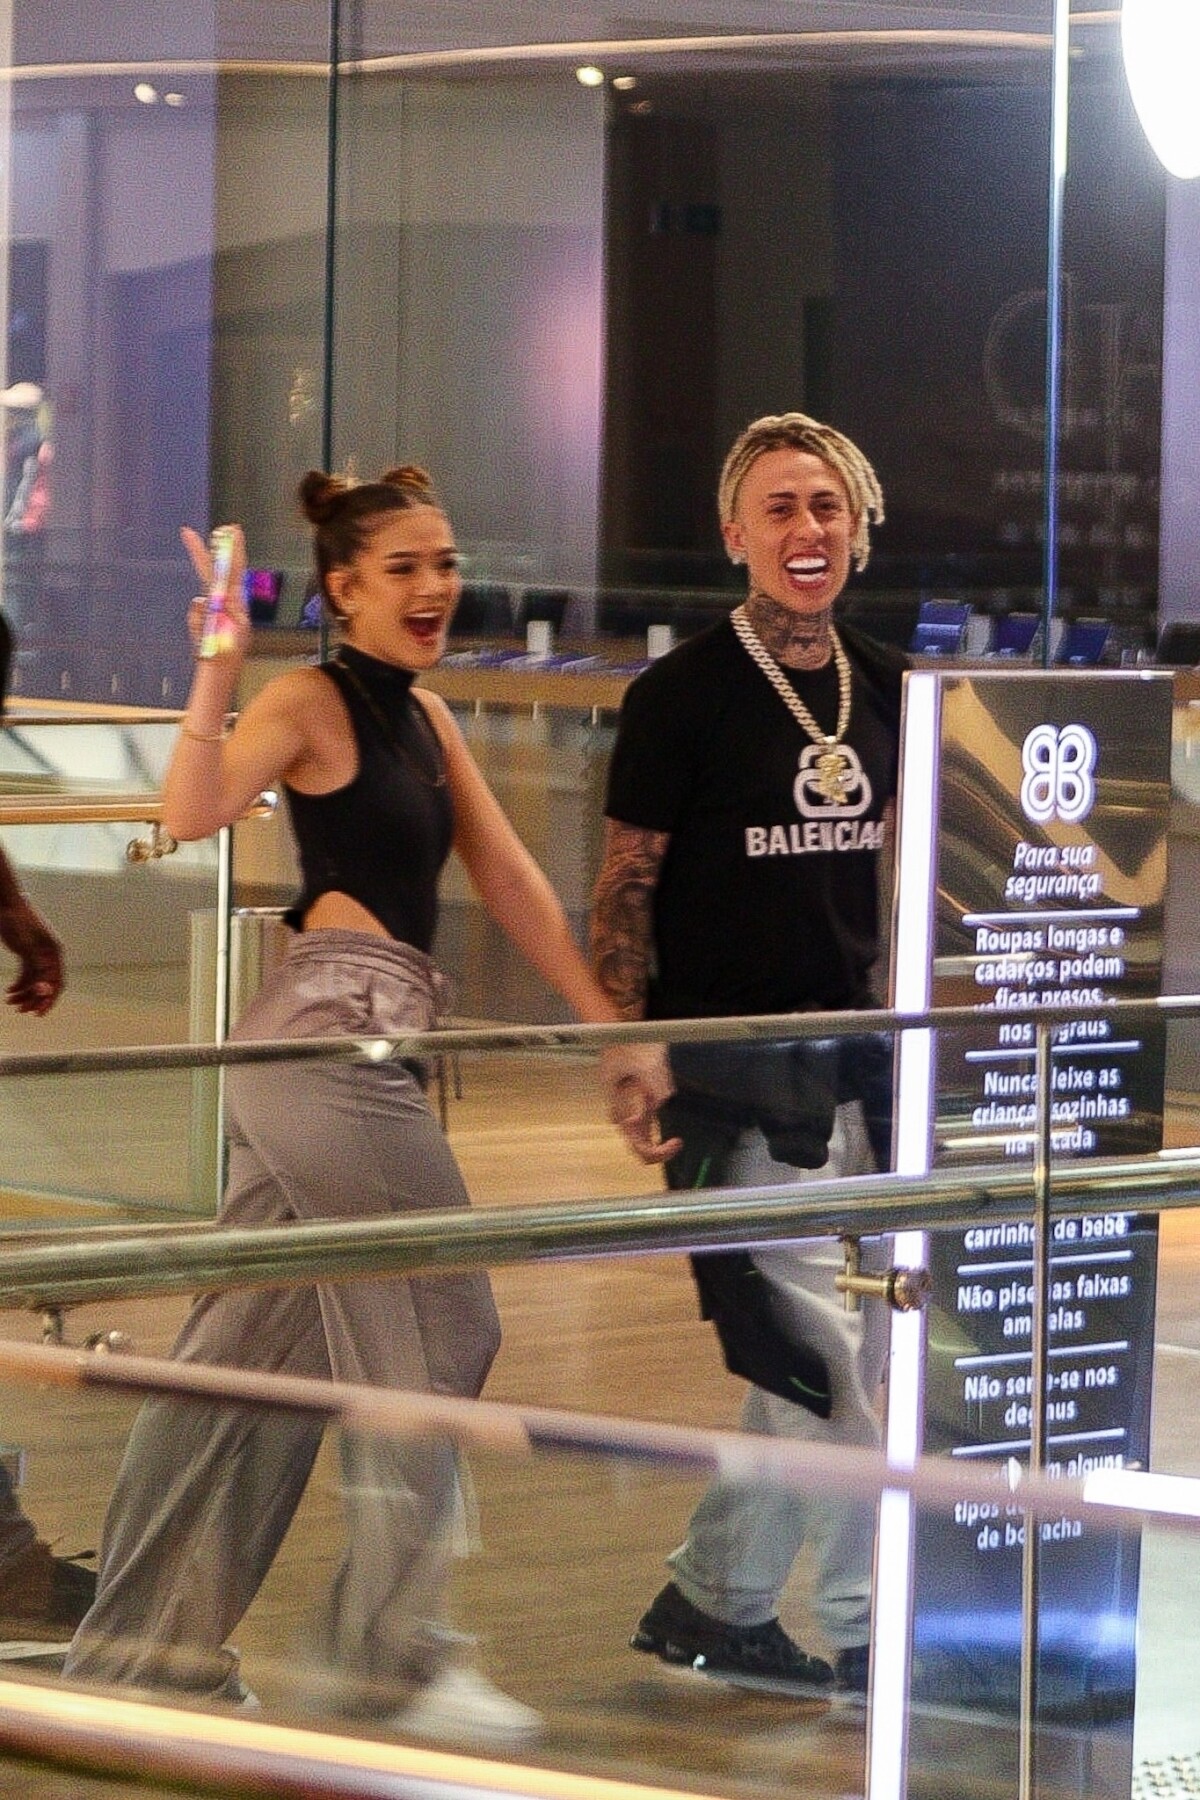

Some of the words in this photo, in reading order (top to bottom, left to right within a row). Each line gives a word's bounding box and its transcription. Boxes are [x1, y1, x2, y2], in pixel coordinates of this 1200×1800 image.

[1014, 842, 1055, 867] Para
[1060, 845, 1094, 864] sua
[1005, 874, 1100, 901] segurança
[976, 928, 1042, 954] Roupas
[1048, 925, 1108, 951] longas
[1110, 928, 1121, 945] e
[975, 958, 1055, 984] cadarços
[1060, 953, 1121, 982] podem
[999, 1023, 1033, 1042] nos
[1099, 1068, 1119, 1086] as
[1054, 1219, 1076, 1240] de
[957, 1285, 993, 1310] Não
[1077, 1273, 1130, 1298] faixas
[964, 1376, 999, 1400] Não
[1085, 1366, 1116, 1388] nos
[977, 1525, 1000, 1549] de
